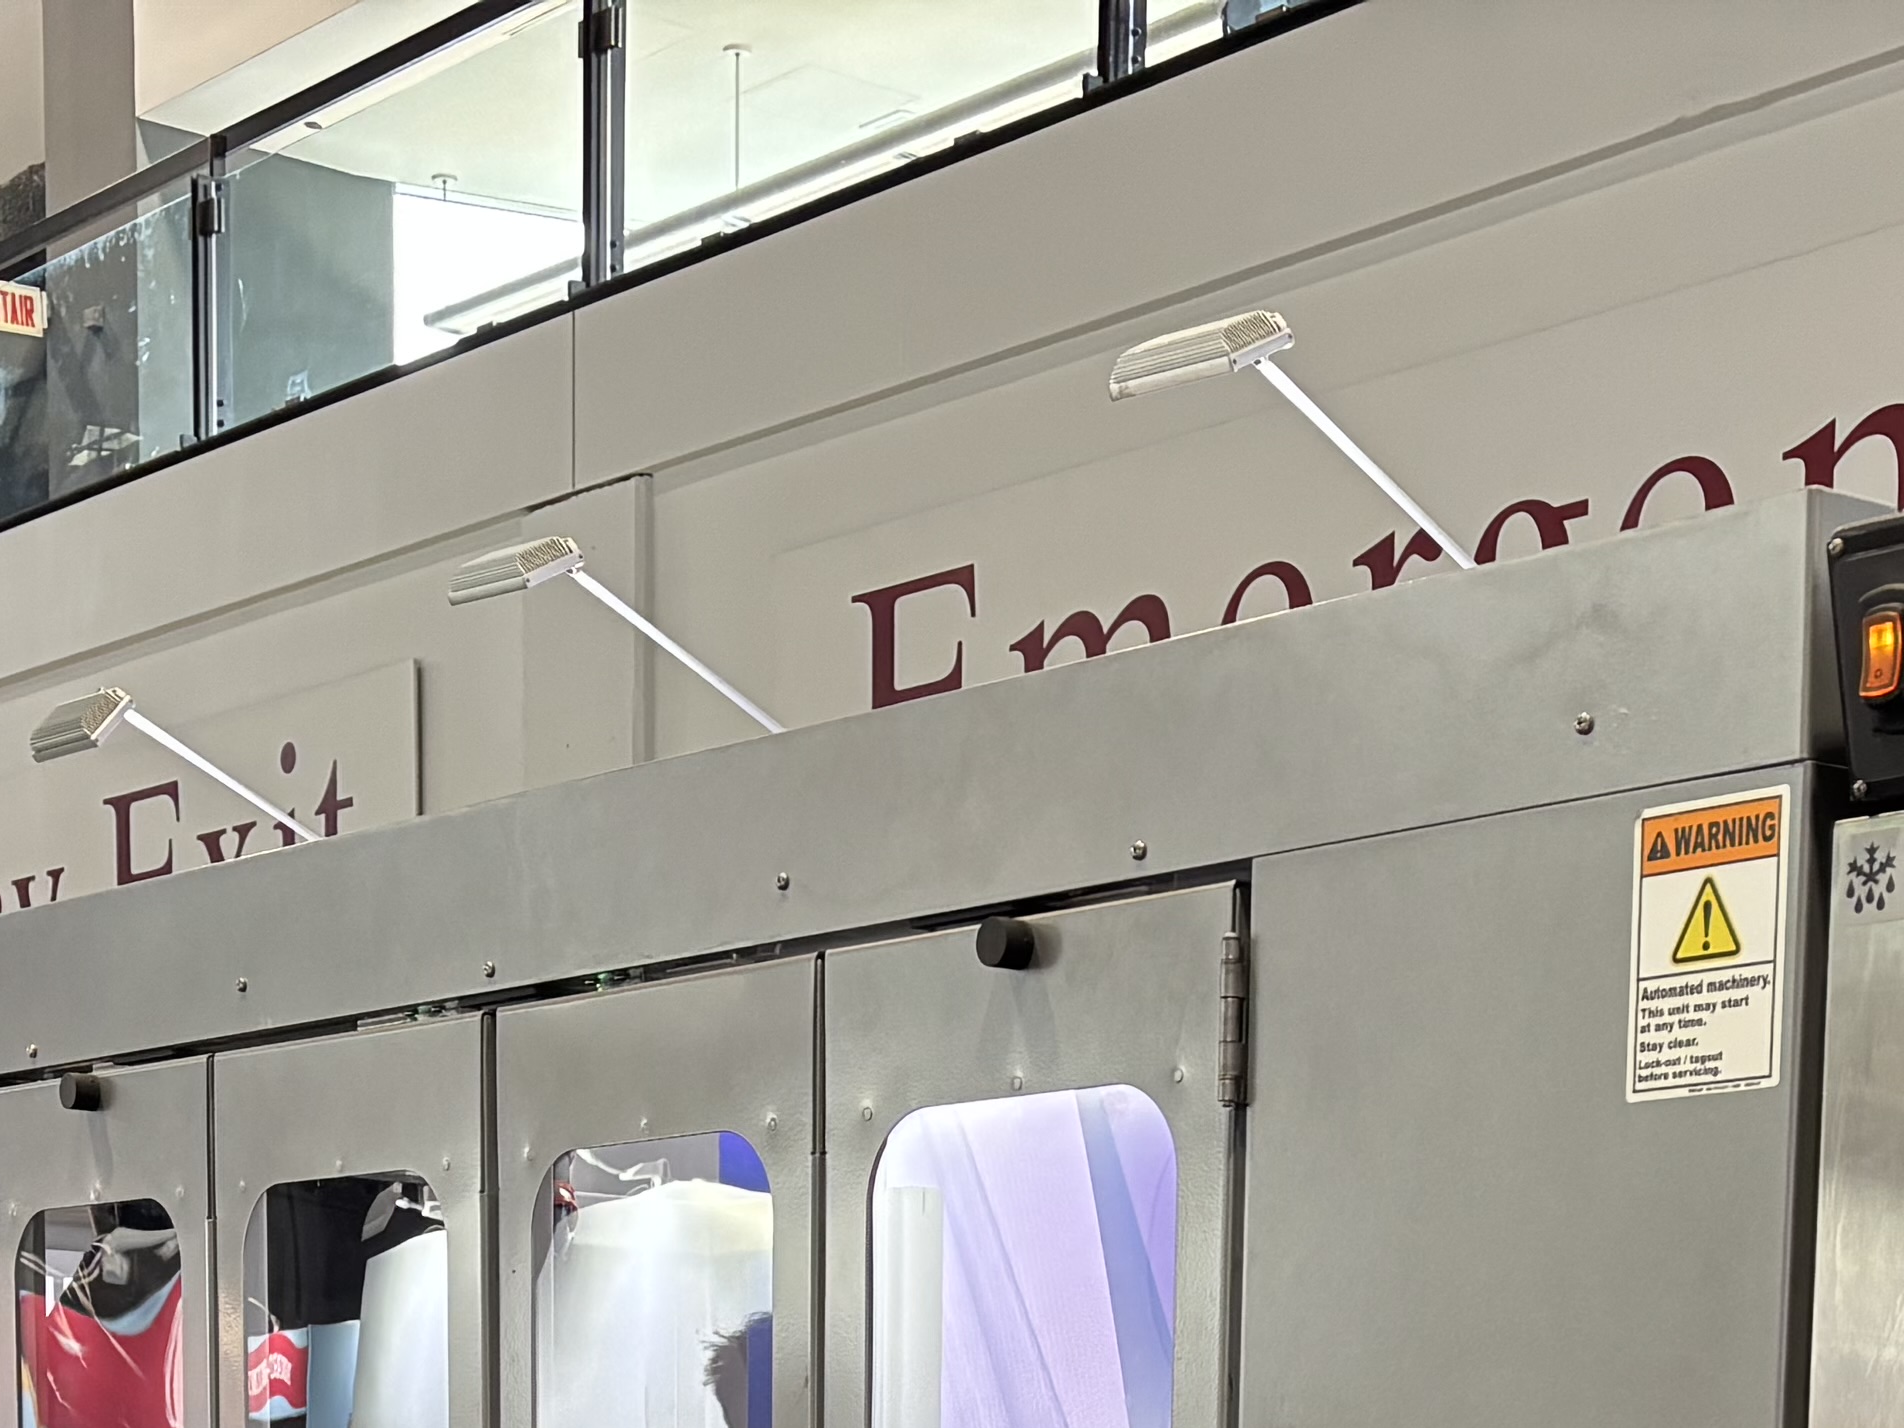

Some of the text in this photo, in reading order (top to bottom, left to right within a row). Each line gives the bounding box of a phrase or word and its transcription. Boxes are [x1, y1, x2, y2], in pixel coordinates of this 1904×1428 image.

[1674, 811, 1777, 857] WARNING
[1641, 974, 1771, 1002] Automated machinery.
[1641, 994, 1750, 1020] This unit may start
[1640, 1016, 1707, 1034] at any time.
[1639, 1036, 1699, 1054] Stay clear.
[1637, 1065, 1722, 1084] before servicing.
